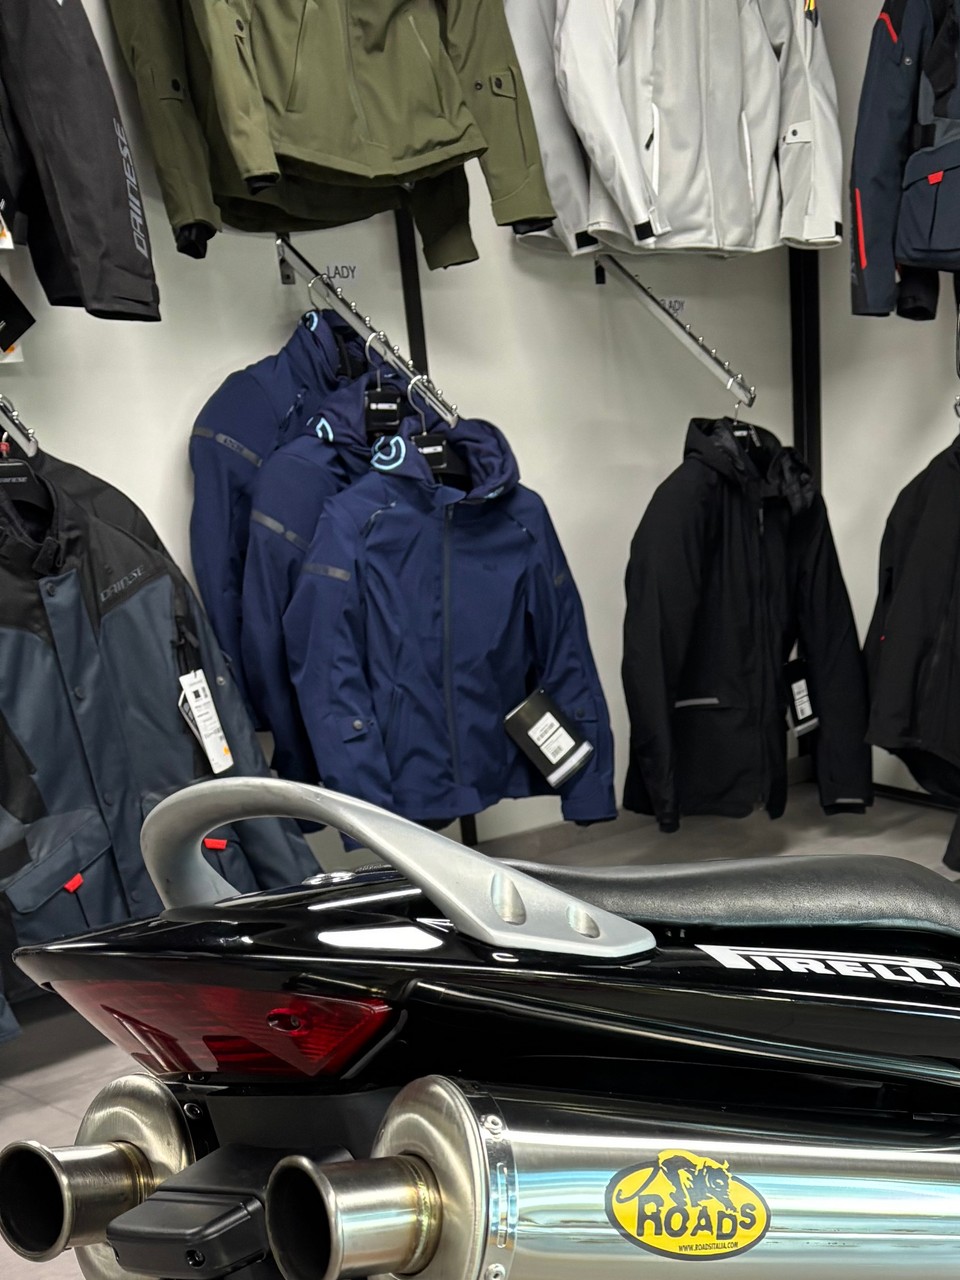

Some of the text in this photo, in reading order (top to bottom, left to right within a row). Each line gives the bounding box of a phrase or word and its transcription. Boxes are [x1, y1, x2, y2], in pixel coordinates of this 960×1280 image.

[113, 117, 149, 260] DAINESE
[326, 265, 356, 279] LADY
[636, 1193, 757, 1241] ROADS
